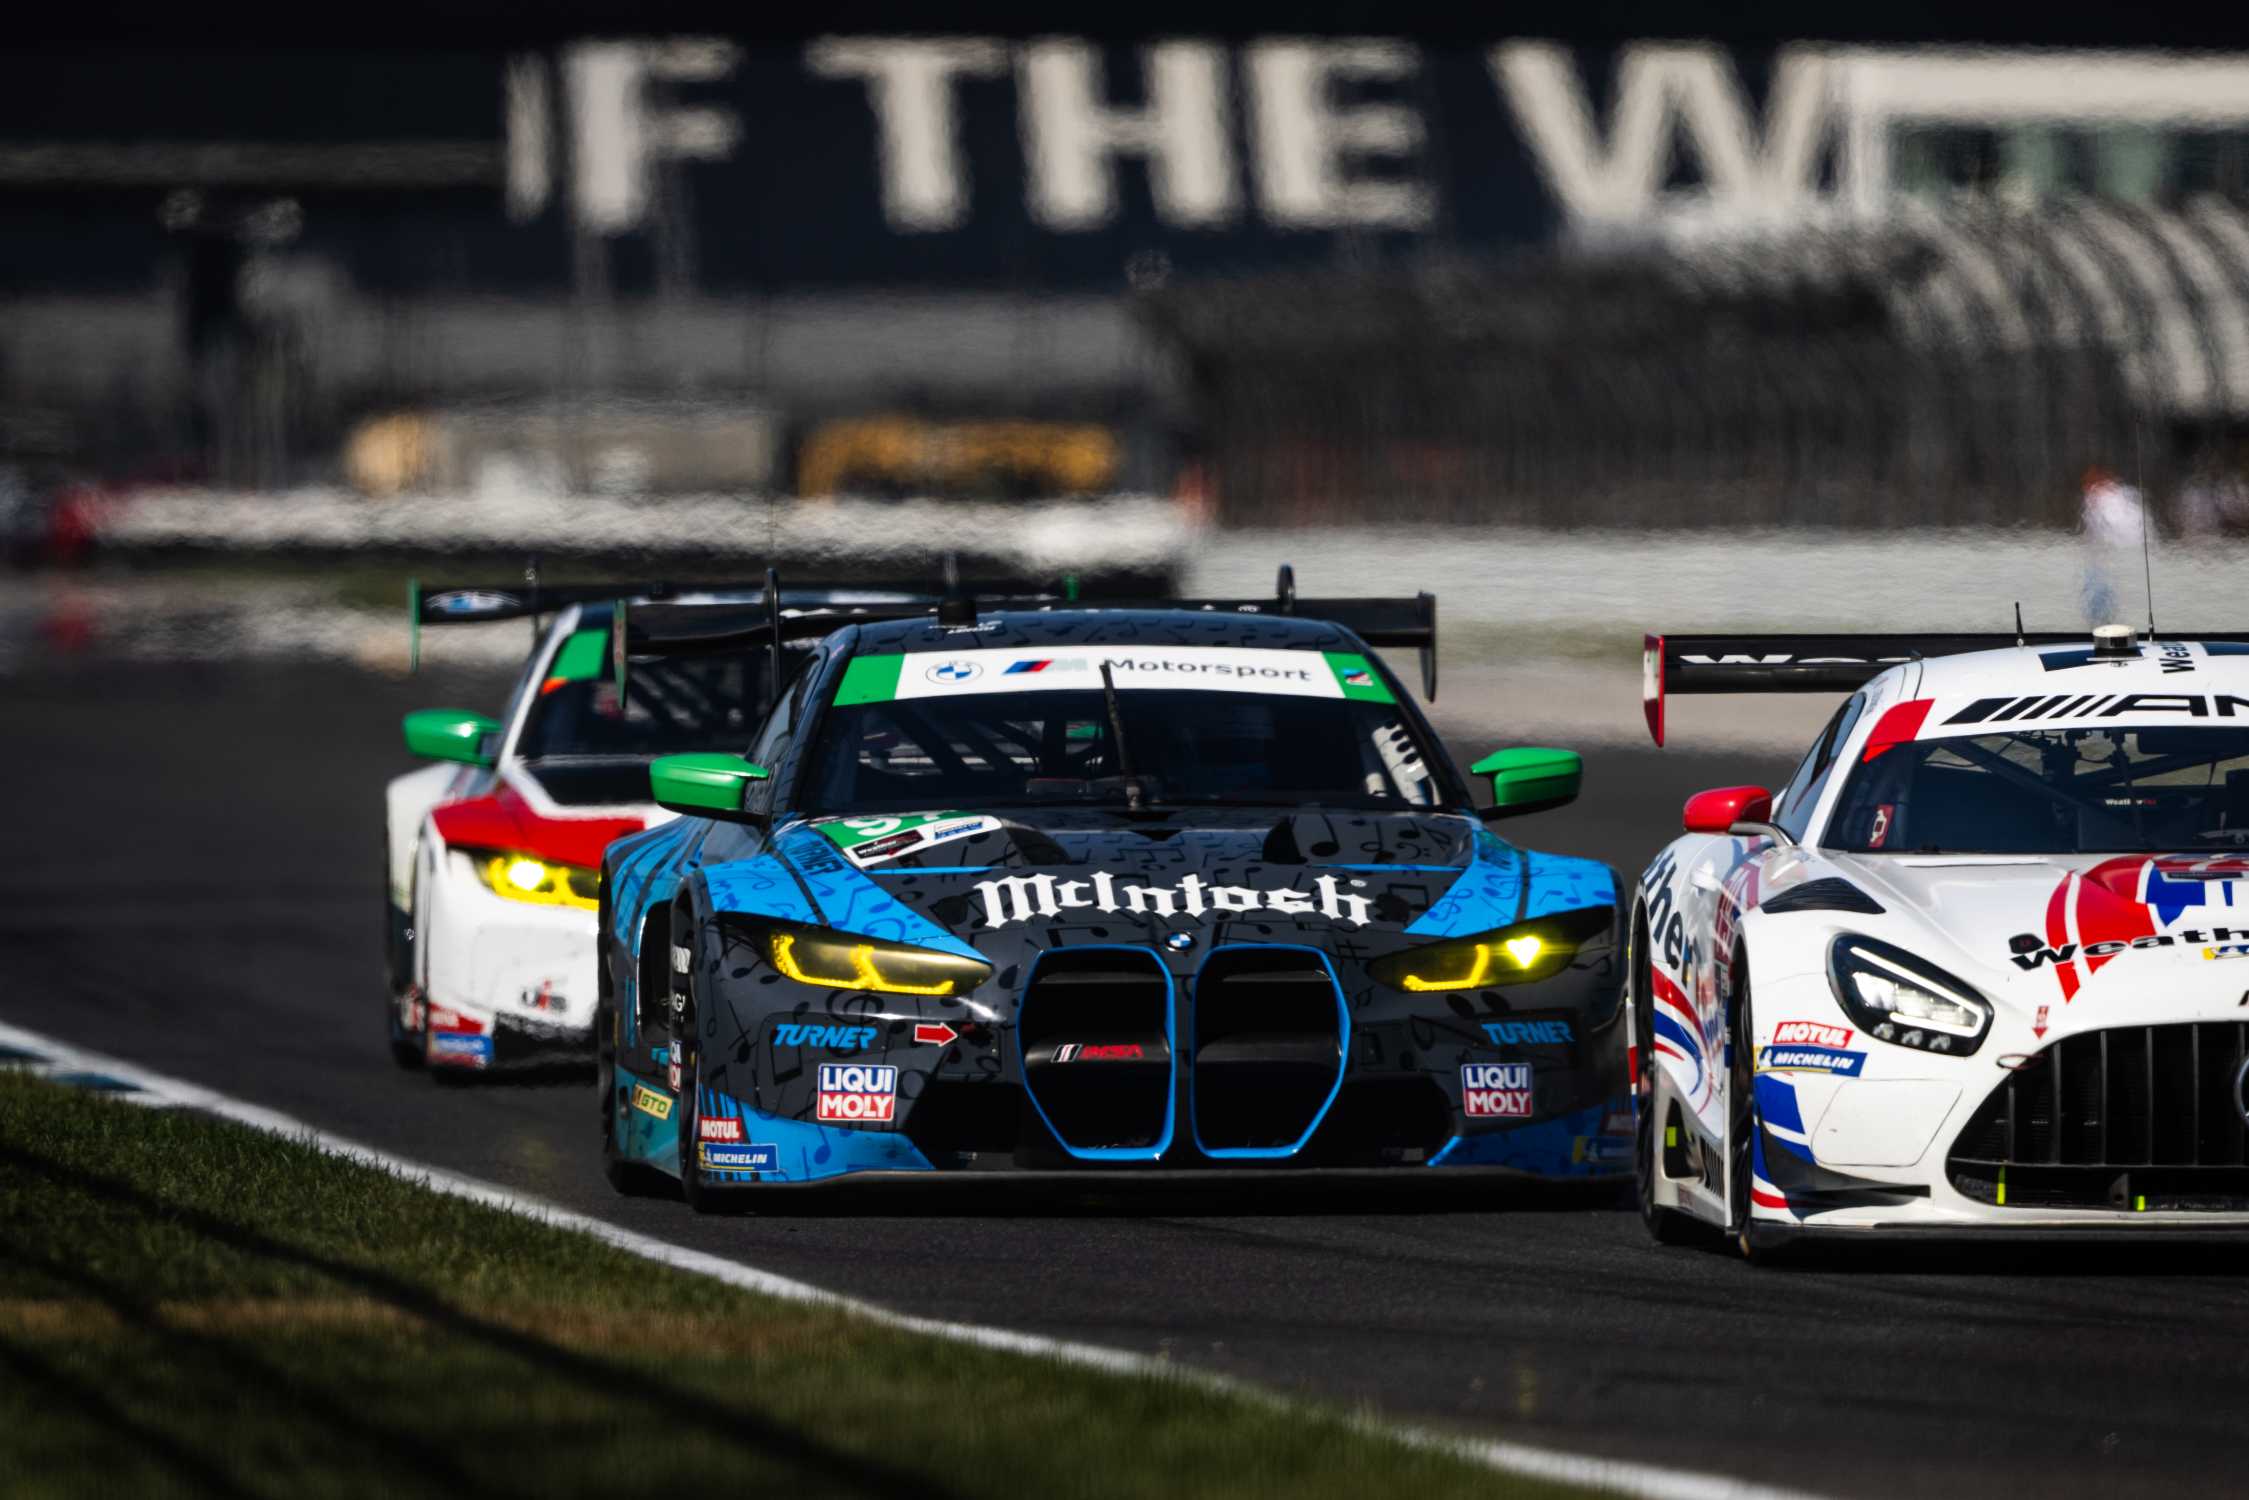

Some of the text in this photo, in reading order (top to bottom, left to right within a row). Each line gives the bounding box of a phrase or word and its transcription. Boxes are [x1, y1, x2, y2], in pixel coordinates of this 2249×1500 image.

[805, 36, 1434, 233] THE
[1105, 658, 1312, 682] Motorsport
[973, 871, 1375, 928] McIntosh
[773, 1023, 879, 1049] TURNER
[1481, 1021, 1576, 1046] TURNER
[1776, 1023, 1847, 1046] MOTUL
[1774, 1052, 1855, 1069] MICHELIN
[822, 1067, 892, 1093] LIQUI
[1465, 1066, 1528, 1089] LIQUI
[821, 1094, 893, 1118] MOLY
[1468, 1091, 1531, 1114] MOLY
[701, 1120, 740, 1139] MOTUL
[712, 1152, 768, 1164] MICHELIN
